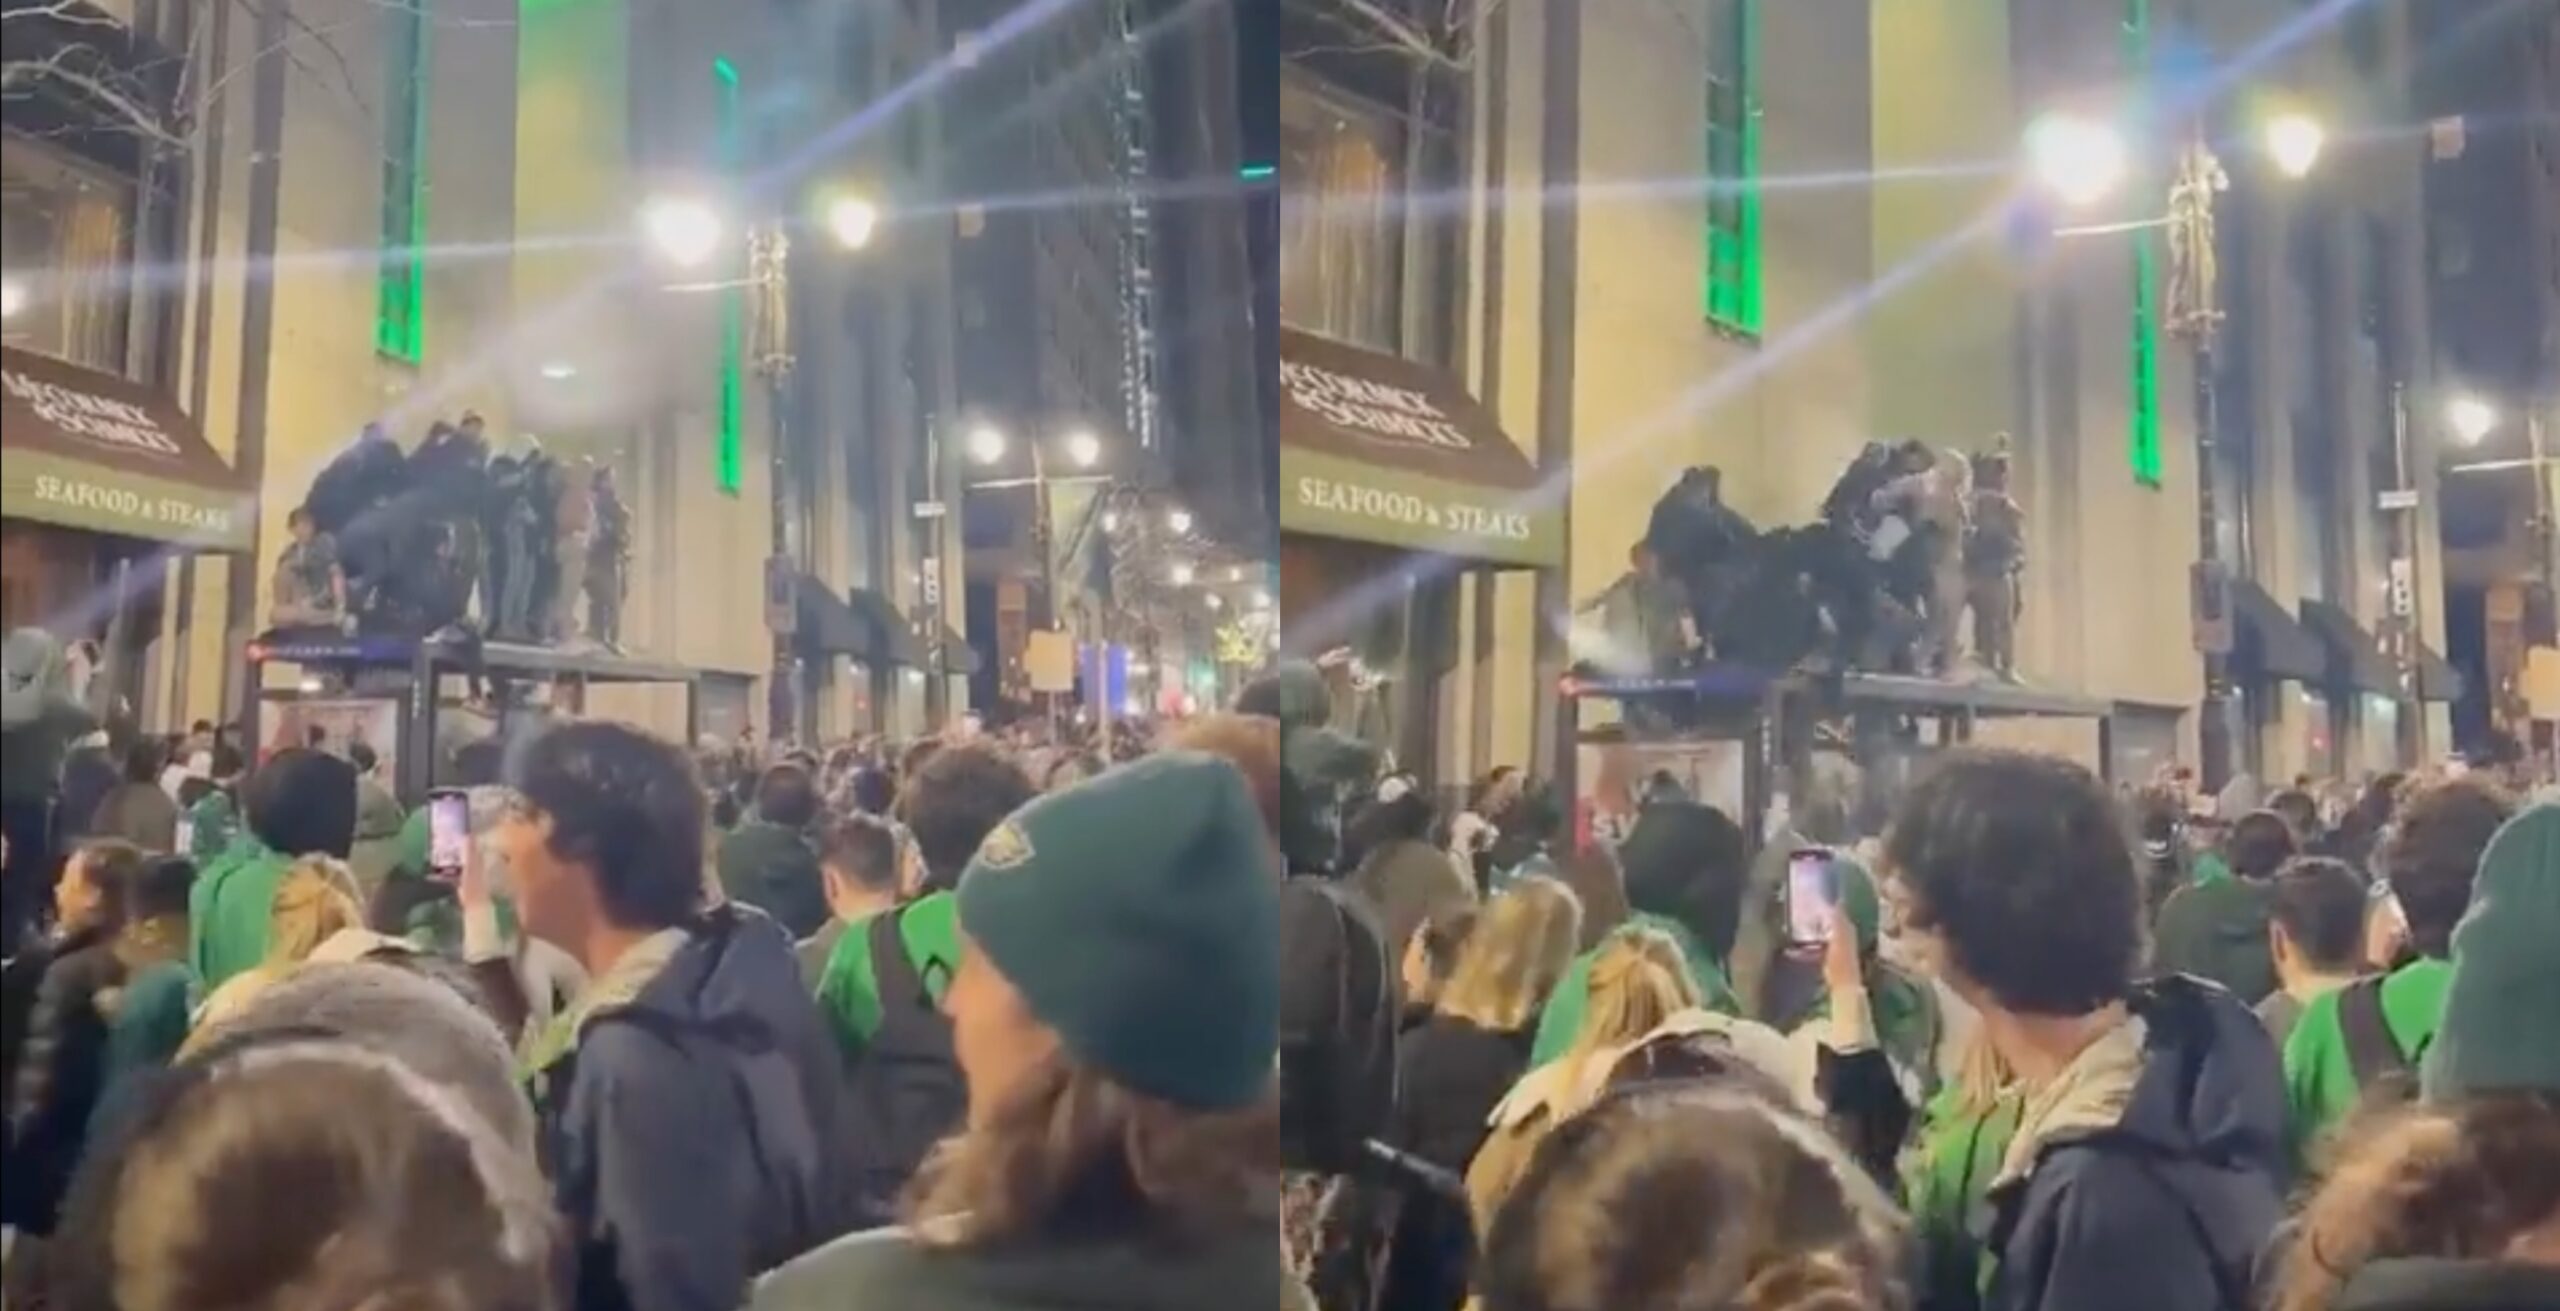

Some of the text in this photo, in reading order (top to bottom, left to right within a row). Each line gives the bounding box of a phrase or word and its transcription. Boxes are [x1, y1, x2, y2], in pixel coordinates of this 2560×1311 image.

[34, 474, 139, 515] SEAFOOD
[157, 498, 231, 532] STEAKS
[1299, 476, 1423, 524] SEAFOOD
[1445, 503, 1530, 540] STEAKS
